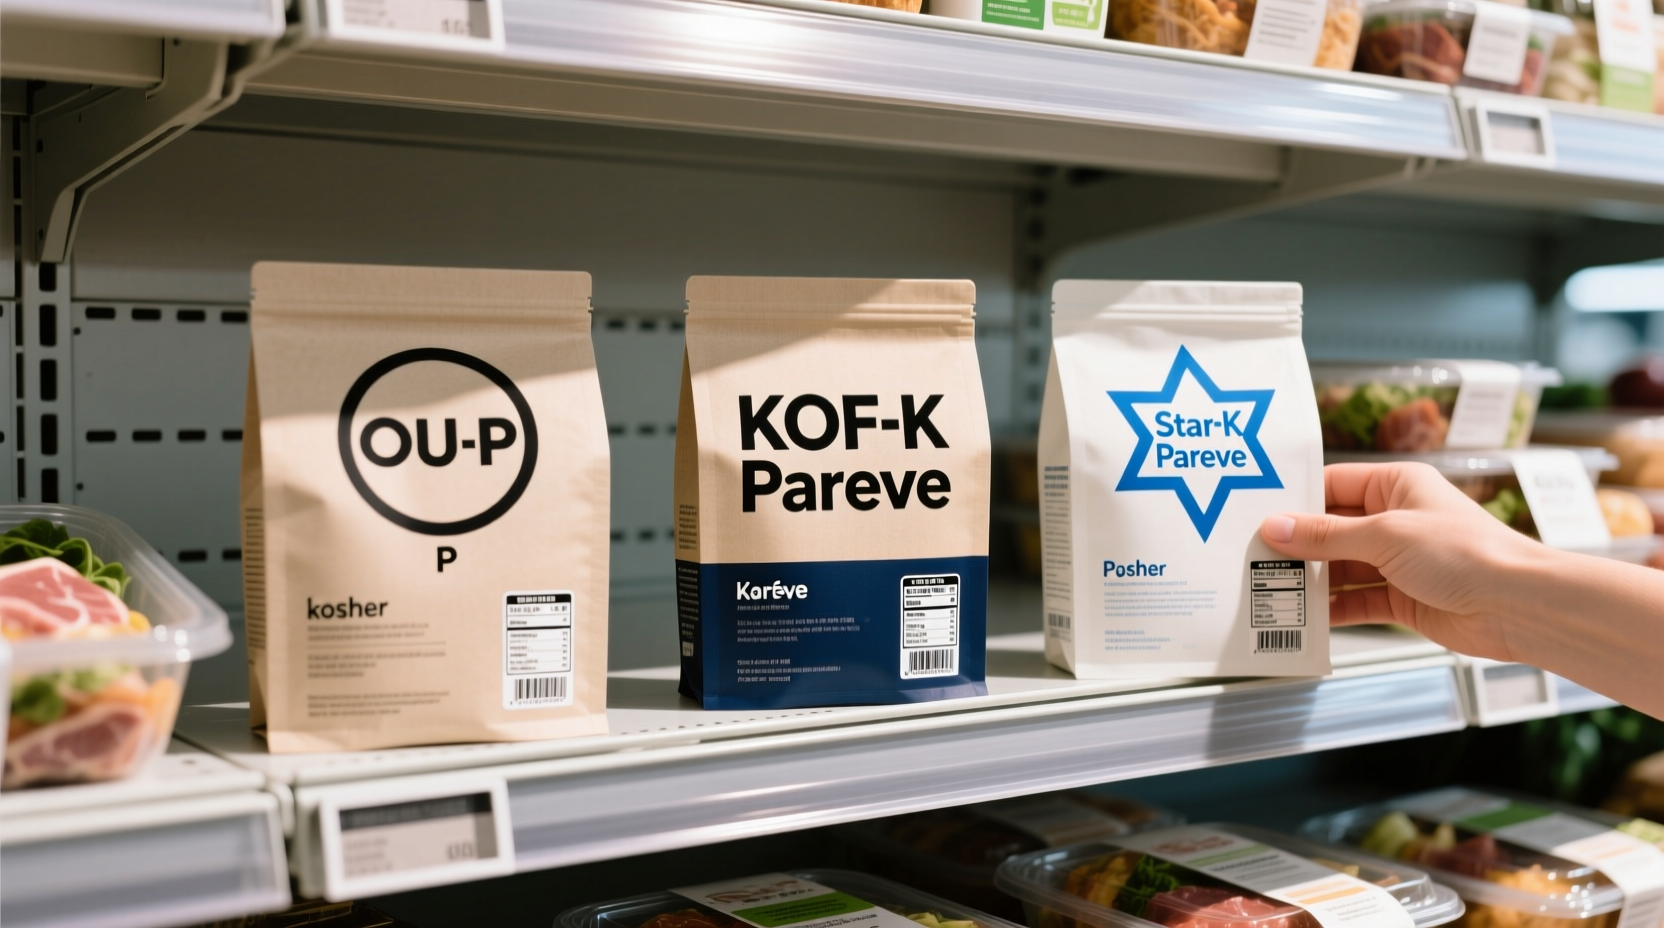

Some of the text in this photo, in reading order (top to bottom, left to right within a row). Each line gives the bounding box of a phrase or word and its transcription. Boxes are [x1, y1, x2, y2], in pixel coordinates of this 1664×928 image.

[738, 394, 950, 451] KOF-K
[1154, 410, 1244, 438] Star-K
[360, 417, 517, 467] OU-P
[1156, 442, 1247, 469] Pareve
[742, 460, 951, 513] Pareve
[437, 546, 457, 573] P
[1103, 559, 1167, 578] Posher
[306, 596, 388, 621] kosher
